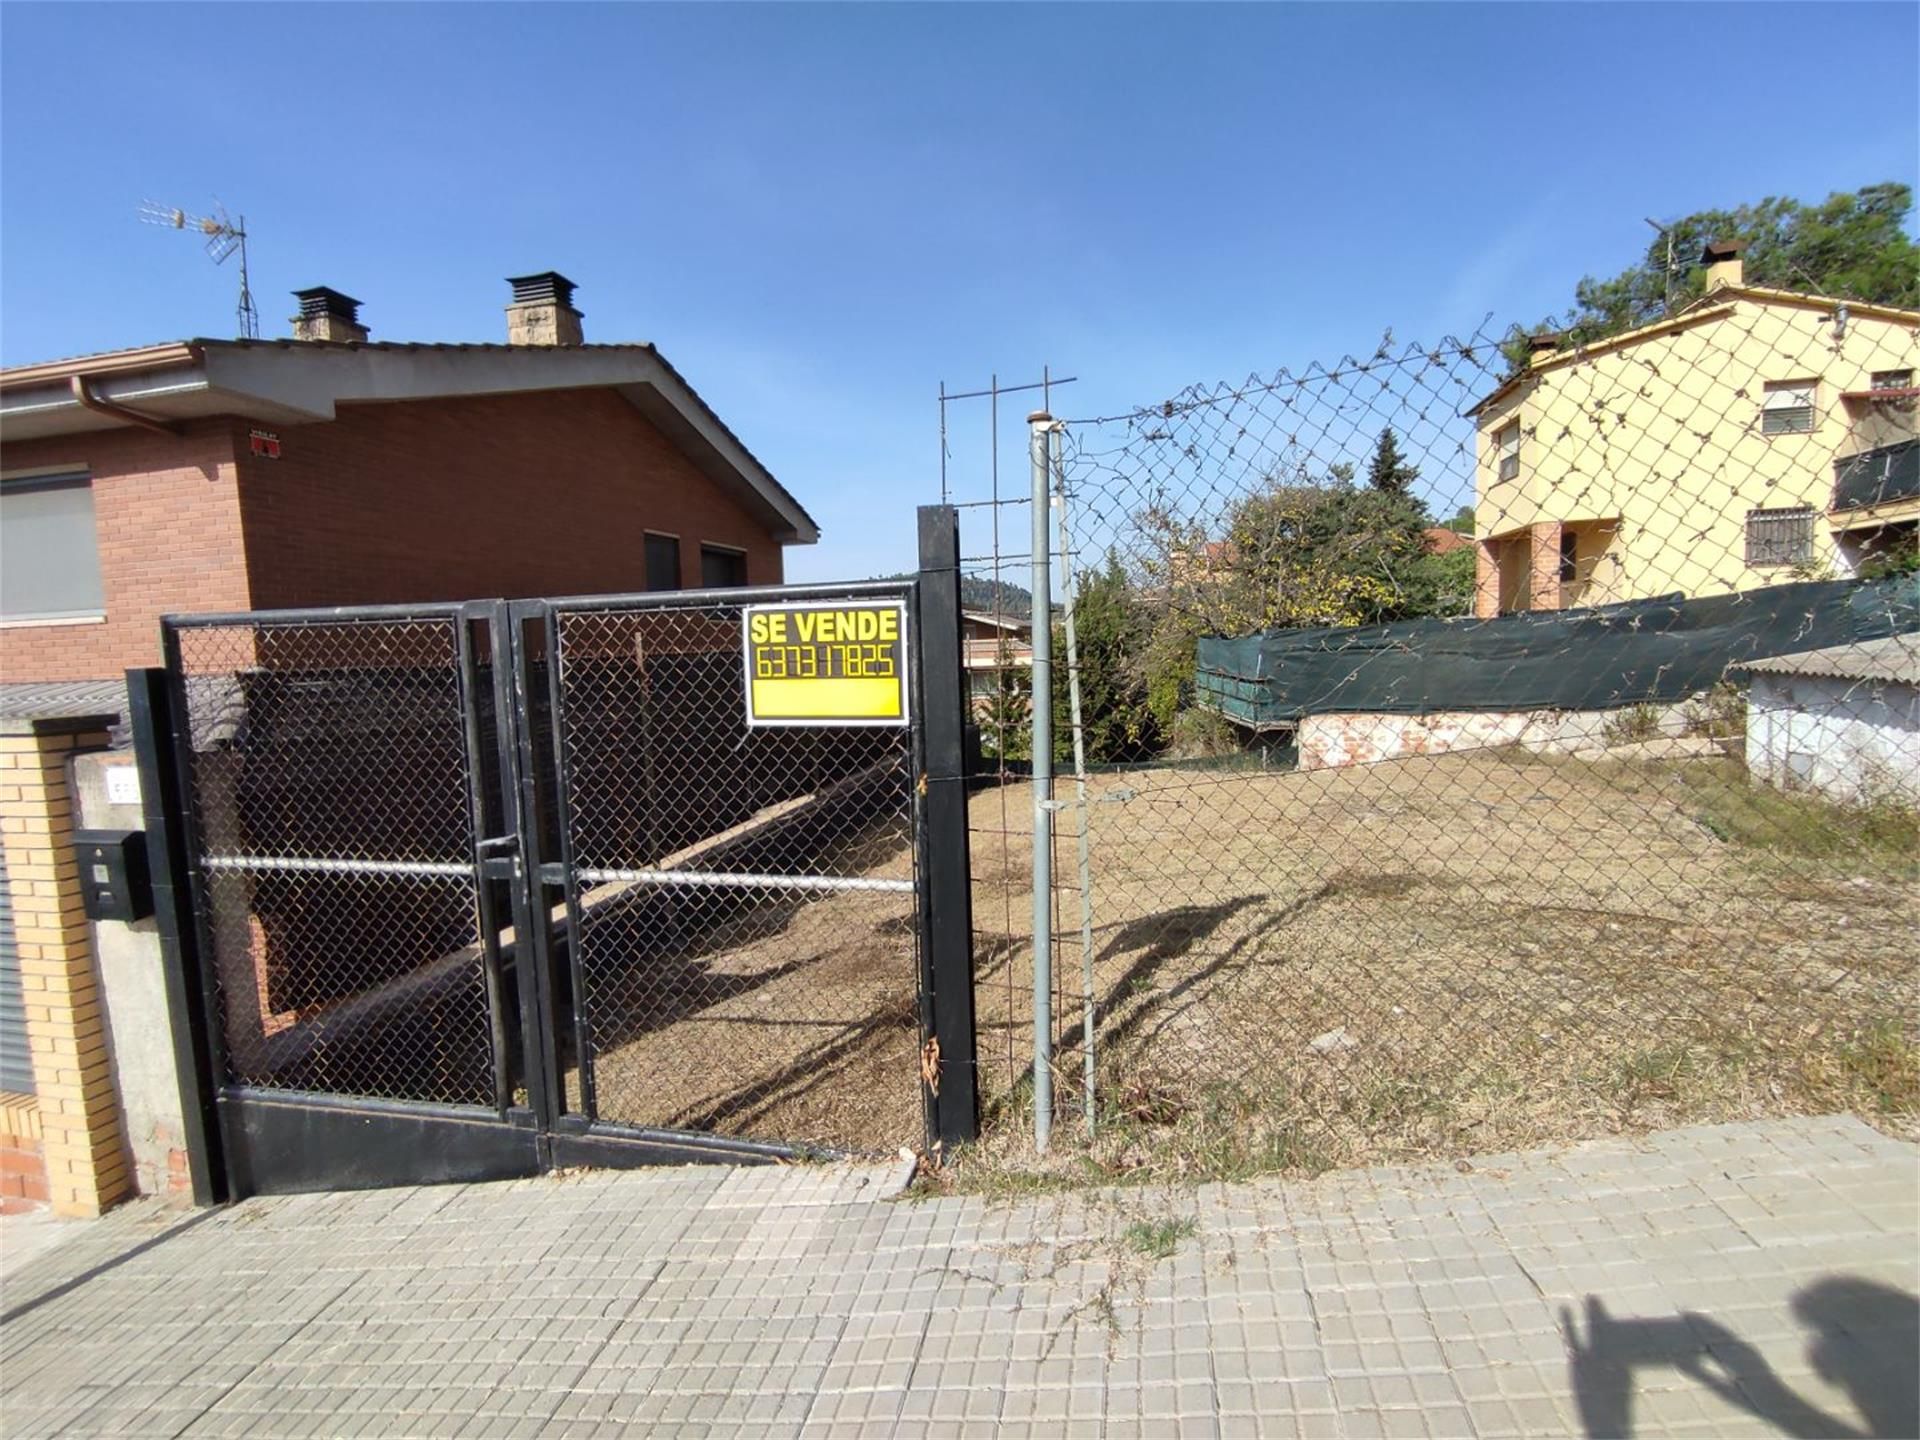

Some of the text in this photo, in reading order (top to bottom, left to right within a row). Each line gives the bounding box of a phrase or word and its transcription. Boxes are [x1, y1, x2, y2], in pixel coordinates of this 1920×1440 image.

[751, 610, 898, 643] SE VENDE
[757, 644, 894, 677] 637317825
